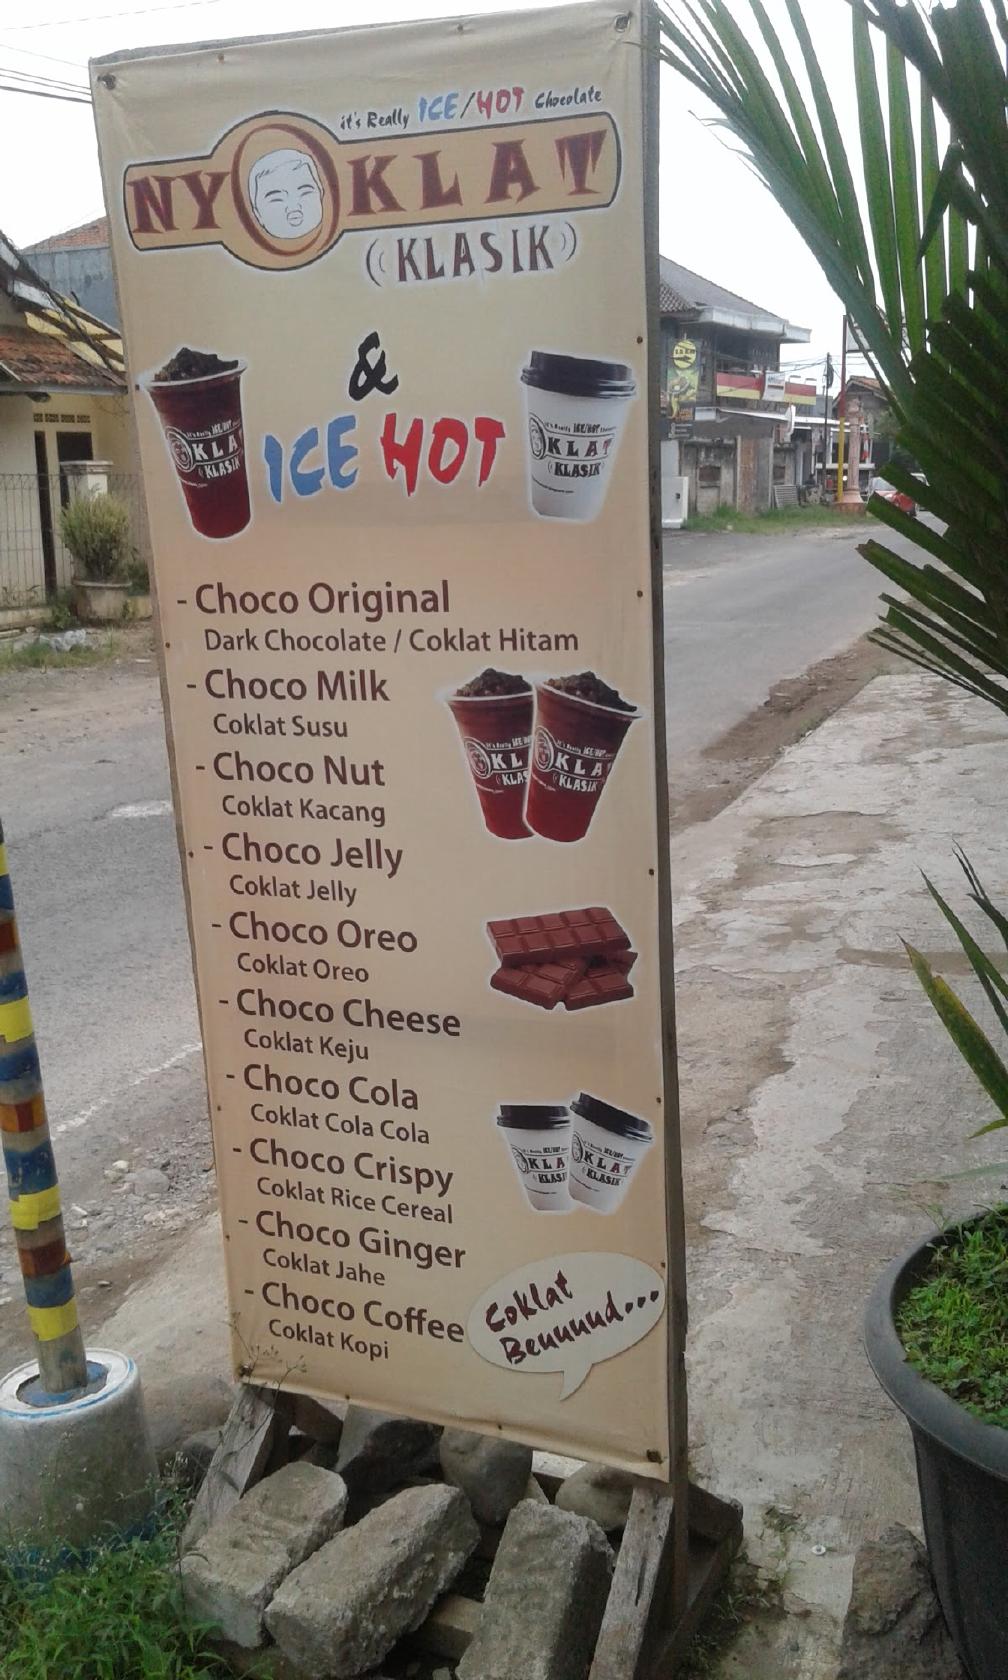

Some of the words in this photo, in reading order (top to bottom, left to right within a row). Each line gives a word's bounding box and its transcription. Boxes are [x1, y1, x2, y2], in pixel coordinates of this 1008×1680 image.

[367, 108, 410, 129] Really
[534, 85, 602, 109] Chocolate
[349, 331, 399, 401] &
[264, 415, 359, 502] ICE
[380, 412, 506, 497] HOT
[195, 581, 299, 615] Choco
[308, 579, 450, 623] Original
[204, 627, 260, 651] Dark
[264, 627, 387, 652] Chocolate
[409, 627, 492, 652] Coklat
[498, 627, 579, 652] Hitam
[204, 667, 308, 701] Choco
[317, 668, 391, 702] Milk
[213, 712, 287, 737] Coklat
[291, 714, 348, 738] Susu
[213, 750, 314, 784] Choco
[323, 754, 386, 787] Nut
[222, 794, 294, 819] Coklat
[299, 797, 386, 828] Kacang
[221, 831, 322, 866] Choco
[330, 838, 404, 880] Jelly
[229, 874, 302, 900] Coklat
[306, 879, 357, 908] Jelly
[229, 910, 329, 946] Choco
[336, 919, 418, 953] Oreo
[237, 952, 308, 978] Coklat
[312, 958, 370, 983] Oreo
[236, 988, 335, 1023] Choco
[342, 998, 461, 1037] Cheese
[244, 1028, 314, 1054] Coklat
[319, 1035, 369, 1065] Keju
[243, 1063, 340, 1100] Choco
[348, 1075, 419, 1111] Cola
[250, 1103, 320, 1130] Coklat
[324, 1112, 374, 1137] Cola
[379, 1119, 430, 1145] Cola
[249, 1137, 345, 1175] Choco
[353, 1152, 454, 1196] Crispy
[256, 1176, 326, 1205] Coklat
[330, 1186, 376, 1212] Rice
[381, 1194, 453, 1225] Cereal
[255, 1210, 351, 1248] Choco
[358, 1226, 466, 1270] Ginger
[262, 1247, 331, 1277] Coklat
[335, 1259, 386, 1287] Jahe
[261, 1281, 355, 1321] Choco
[363, 1300, 465, 1343] Coffee
[486, 1270, 573, 1333] Coklat
[268, 1318, 335, 1348] Coklat
[340, 1331, 389, 1361] Kopi
